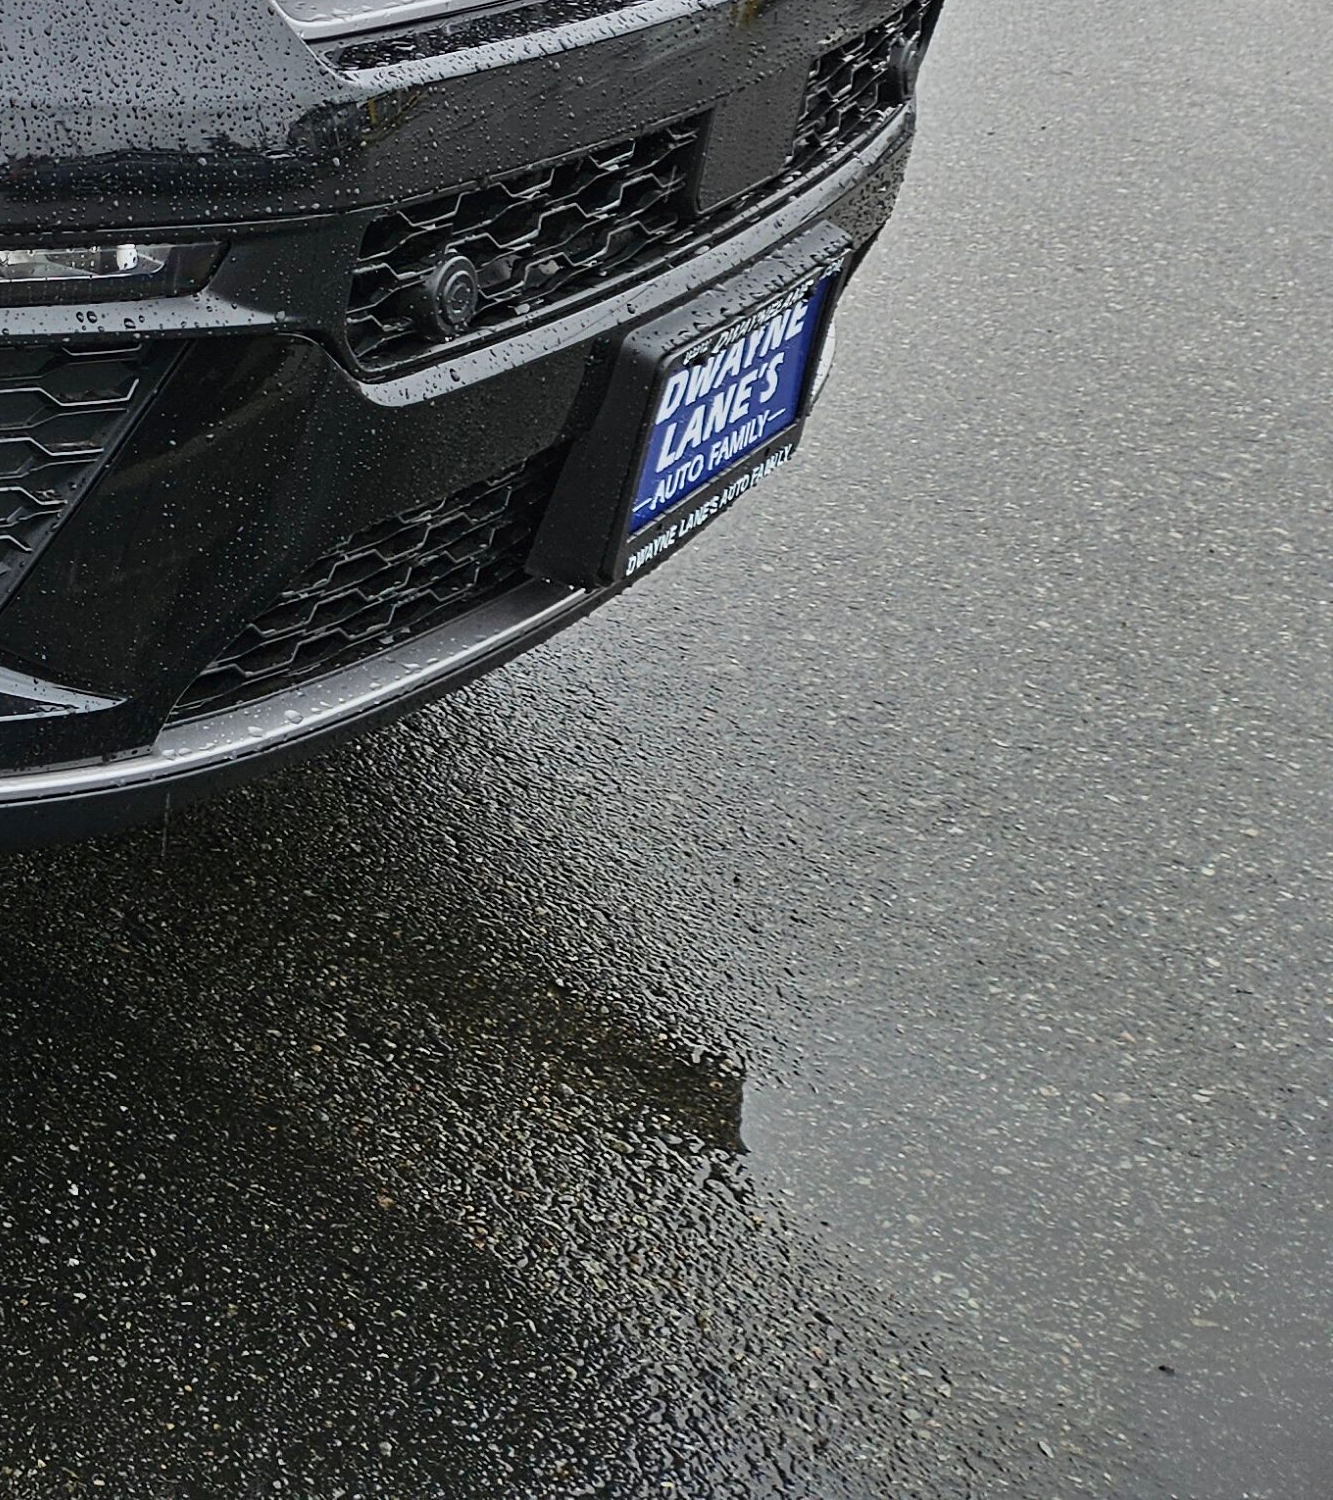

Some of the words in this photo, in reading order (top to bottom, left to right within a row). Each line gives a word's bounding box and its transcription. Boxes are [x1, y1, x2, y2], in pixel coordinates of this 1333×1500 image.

[655, 299, 808, 425] DWAYNE
[656, 352, 785, 473] LANE'S
[626, 524, 678, 576] DWAYNE
[719, 474, 750, 508] AUTO
[750, 443, 793, 486] FAMILY
[649, 454, 704, 511] AUTO
[708, 409, 771, 471] FAMILY
